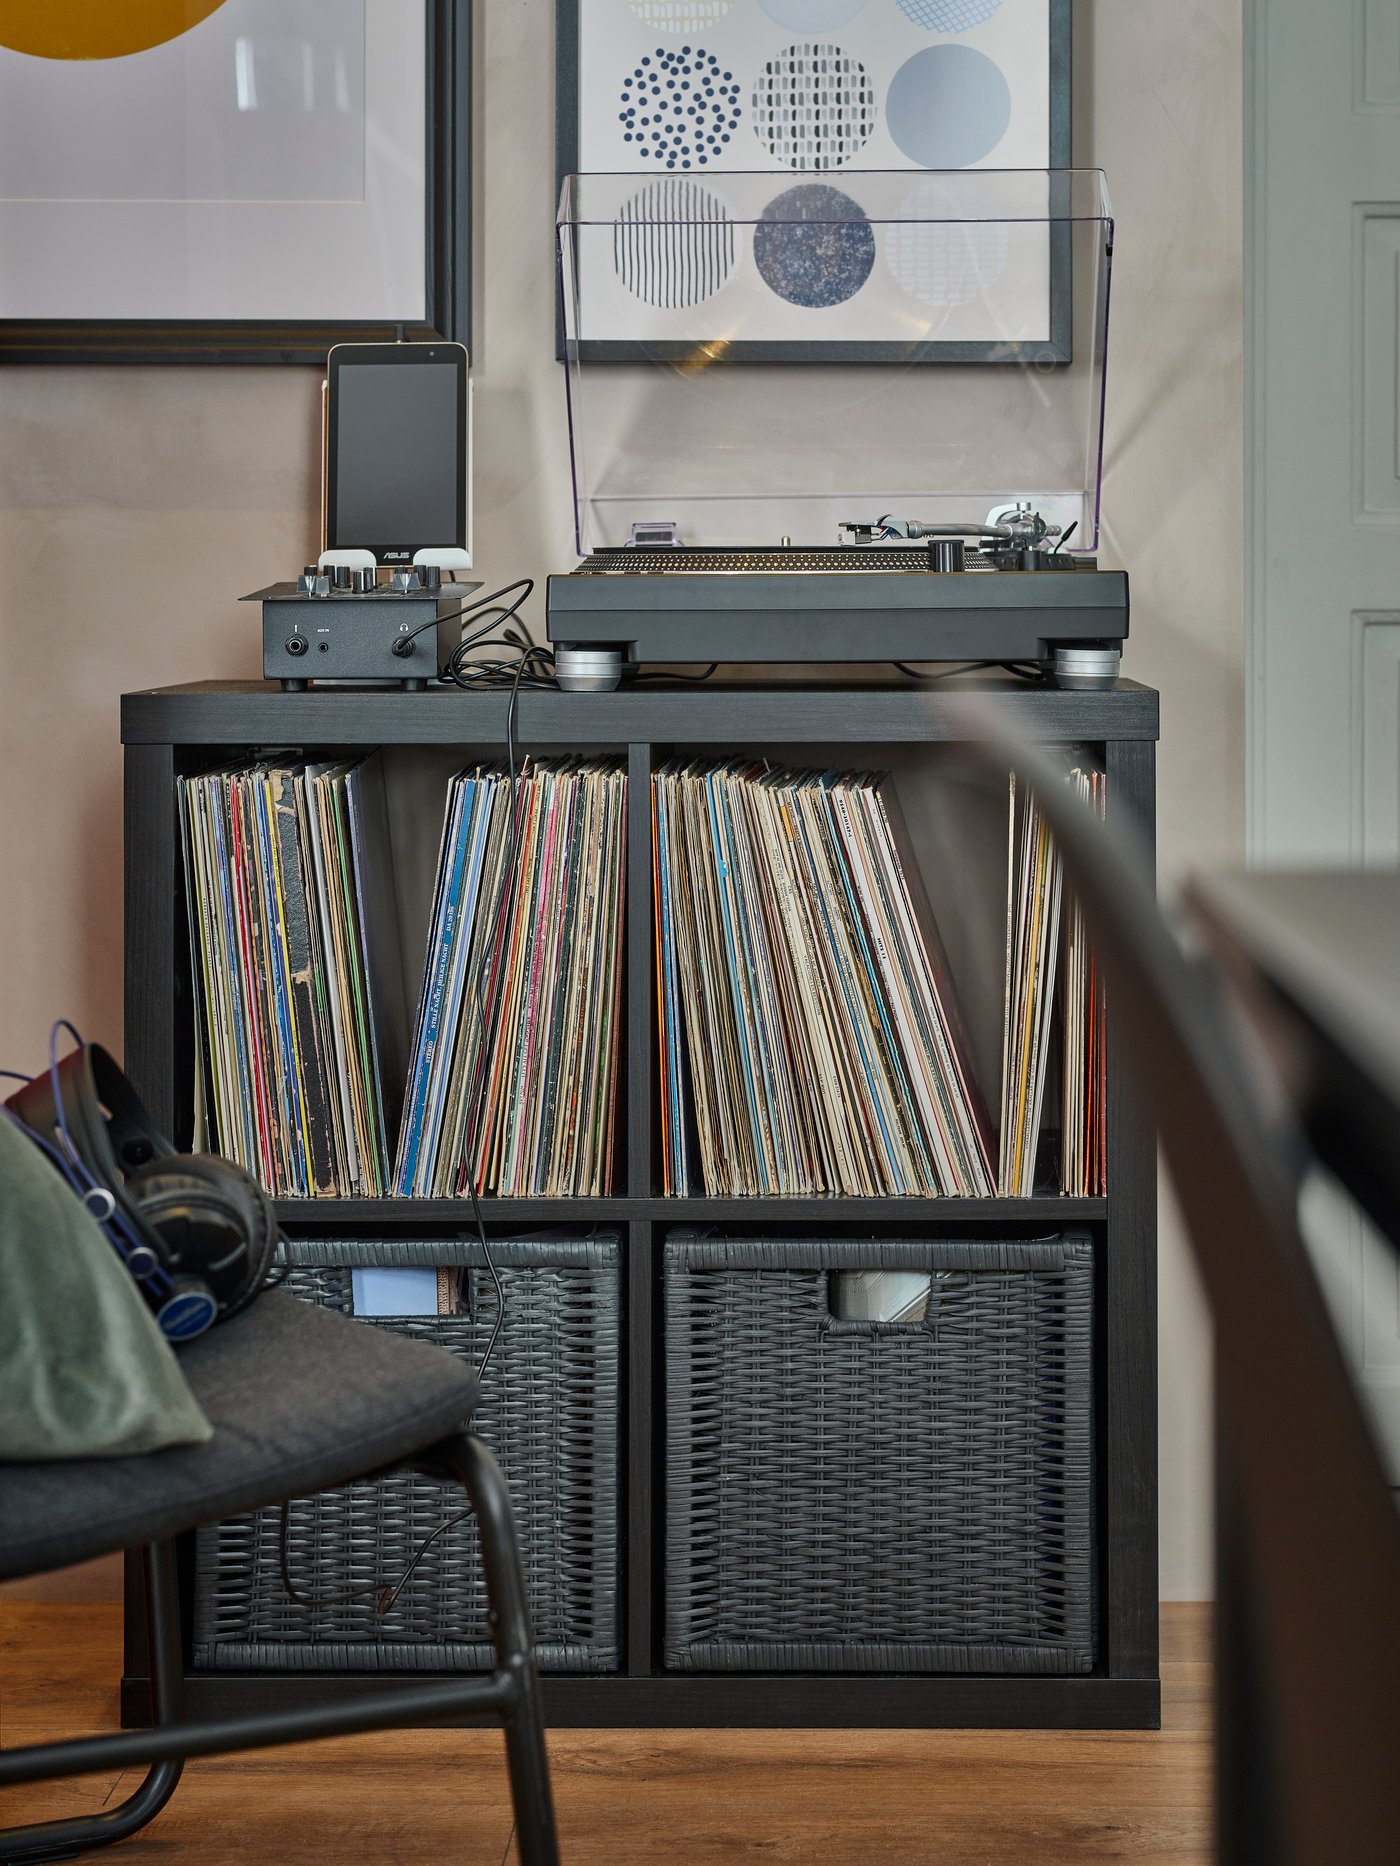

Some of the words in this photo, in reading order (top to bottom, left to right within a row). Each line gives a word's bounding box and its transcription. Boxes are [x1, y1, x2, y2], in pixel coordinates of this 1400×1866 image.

[876, 937, 884, 951] HITS
[430, 1009, 438, 1028] STILLE
[441, 943, 449, 962] NACHT
[446, 923, 452, 931] DA
